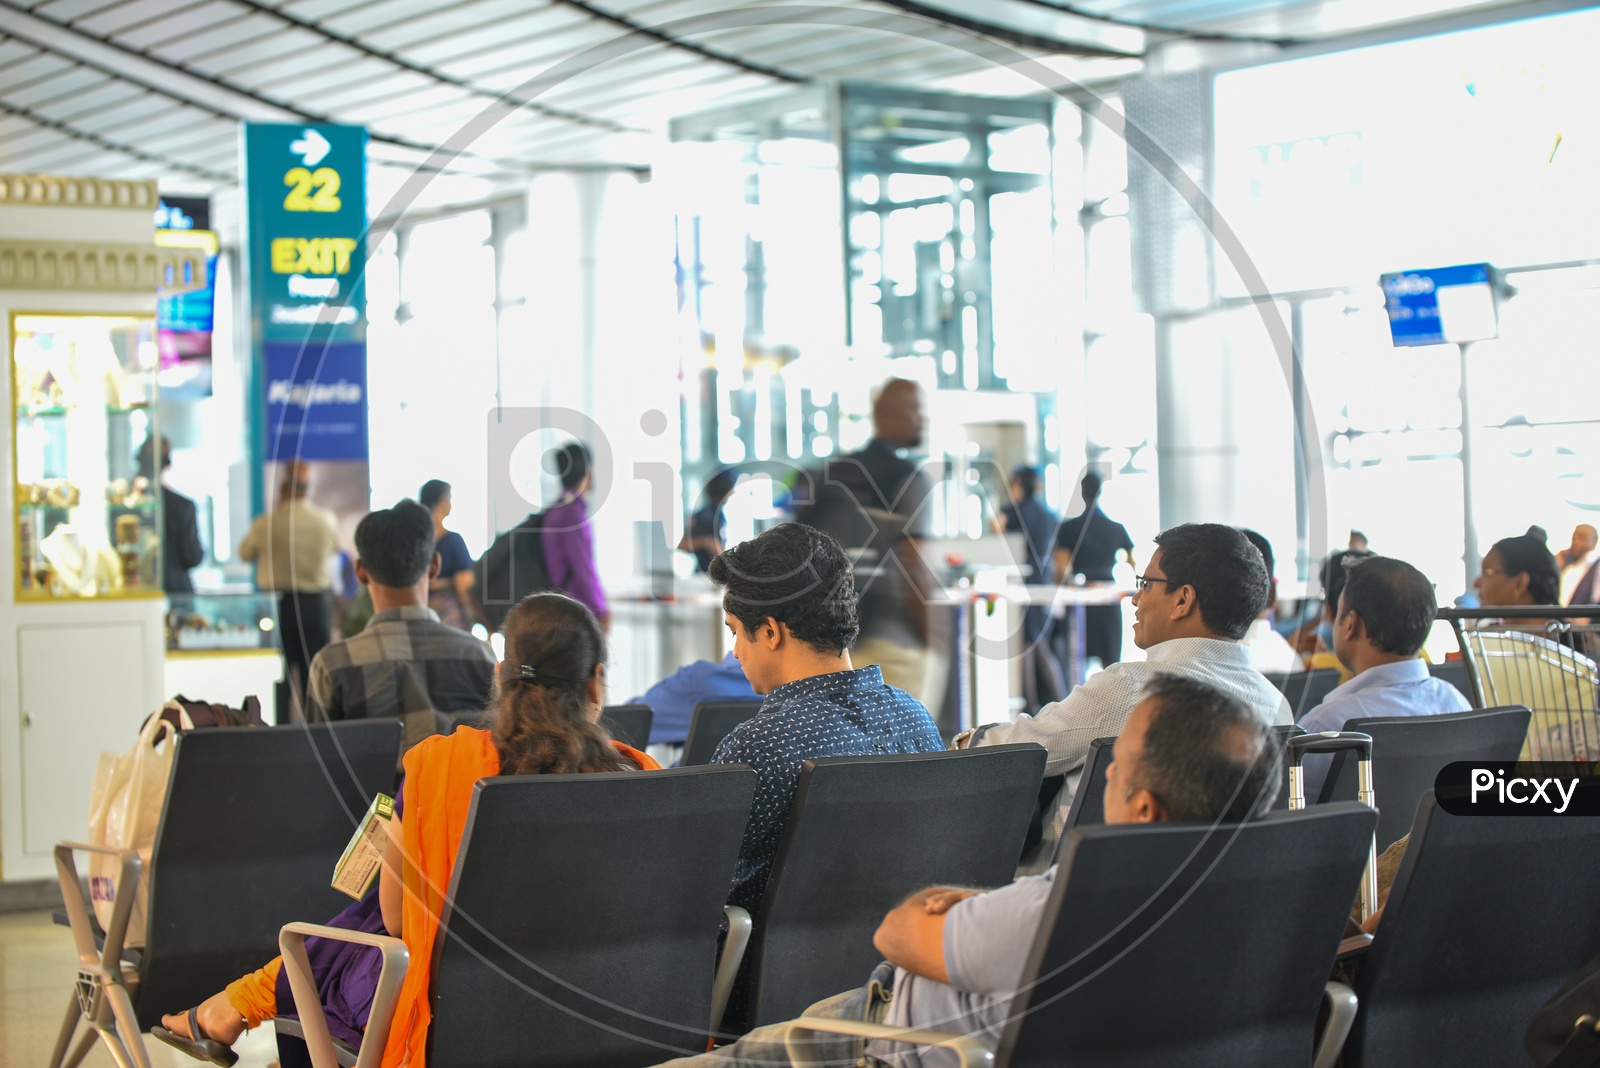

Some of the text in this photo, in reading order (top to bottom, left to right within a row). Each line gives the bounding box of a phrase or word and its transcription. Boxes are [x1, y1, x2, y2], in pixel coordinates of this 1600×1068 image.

[284, 167, 341, 212] 22
[271, 238, 356, 274] EXIT
[269, 379, 361, 409] Kajaria
